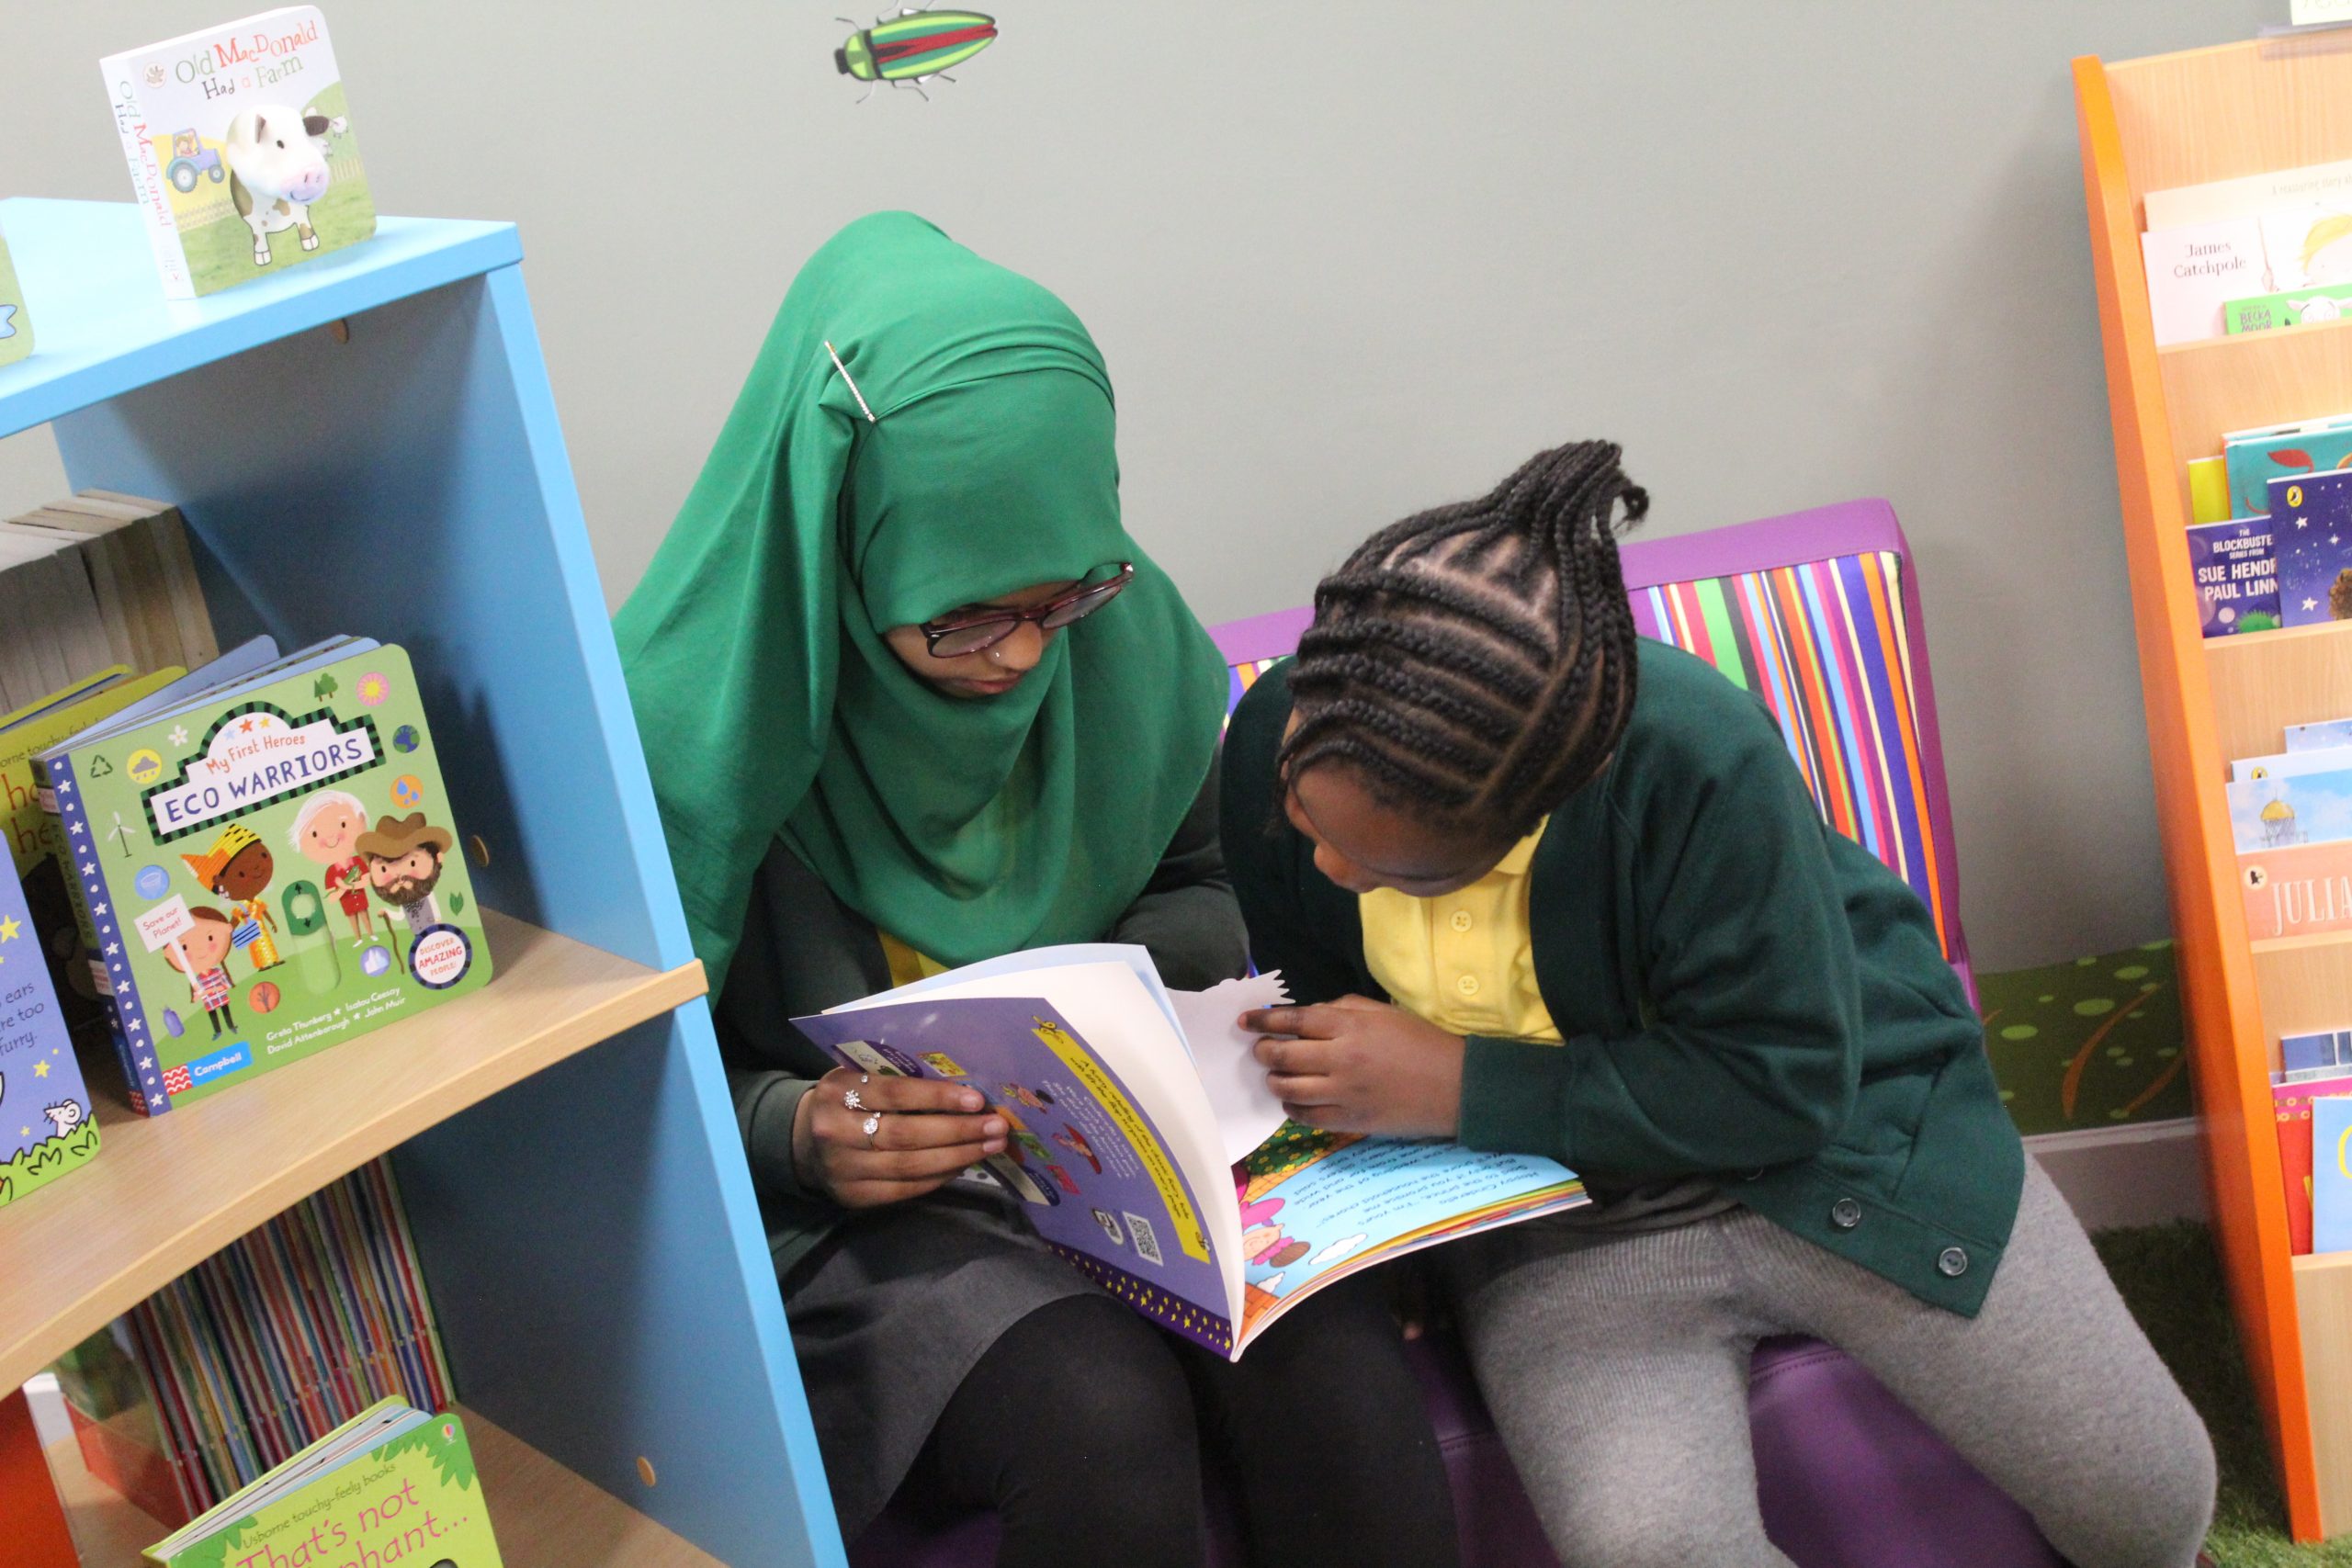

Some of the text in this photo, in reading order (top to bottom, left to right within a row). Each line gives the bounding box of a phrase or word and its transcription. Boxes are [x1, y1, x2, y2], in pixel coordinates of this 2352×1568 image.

[175, 20, 319, 85] Old MacDonald
[201, 55, 304, 100] Had a Farm
[119, 80, 172, 228] Old MacDonald
[2185, 243, 2232, 258] James
[2174, 255, 2247, 278] Catchpole
[2213, 535, 2273, 553] BLOCKBUSTE
[2239, 528, 2250, 537] THE
[2199, 565, 2226, 583] SUE
[2205, 577, 2278, 602] PAUL LINN
[206, 734, 306, 775] My First Heroes
[165, 739, 362, 823] ECO WARRIORS
[143, 908, 178, 931] Save our
[2271, 874, 2352, 938] JULIA
[153, 917, 182, 939] Planet!
[418, 945, 463, 970] AMAZING
[6, 983, 35, 1003] ears
[0, 1002, 44, 1032] re too
[266, 987, 401, 1042] Greta Thunberg Isatou Ceesay
[266, 997, 406, 1055] David Attenborough John Muir
[194, 1052, 243, 1077] Campbell
[243, 1463, 396, 1550] Usborne touchy-feely books
[357, 1478, 419, 1532] not
